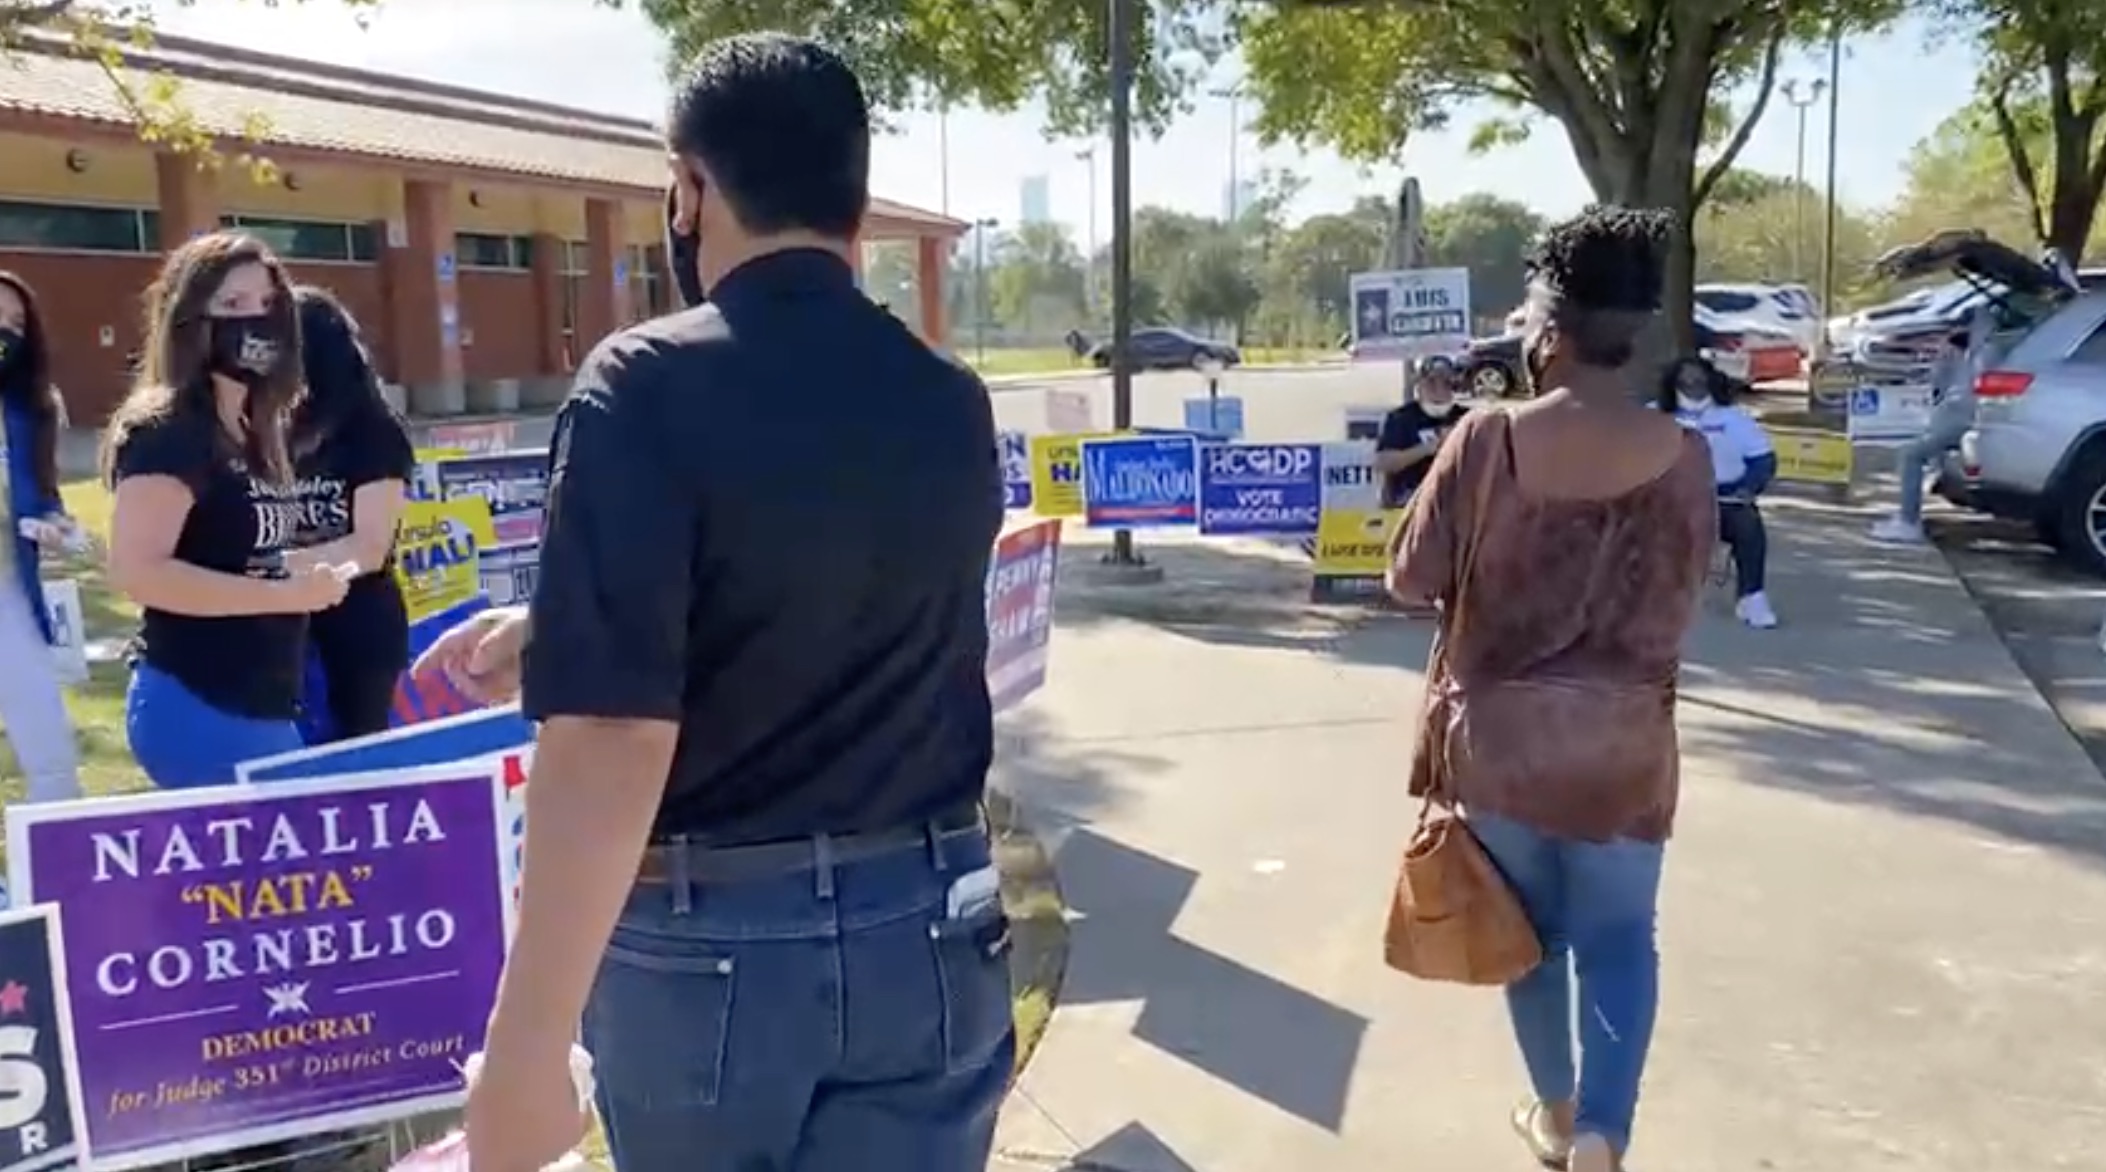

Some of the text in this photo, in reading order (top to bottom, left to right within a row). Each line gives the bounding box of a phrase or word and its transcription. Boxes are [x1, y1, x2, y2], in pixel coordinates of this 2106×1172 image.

[1235, 488, 1285, 507] VOTE
[91, 799, 446, 882] NATALIA
[181, 865, 373, 924] “NATA”
[96, 909, 454, 996] CORNELIO
[202, 1011, 376, 1061] DEMOCRAT
[108, 1088, 146, 1120] for
[154, 1074, 226, 1108] Judge
[303, 1047, 391, 1076] District
[400, 1034, 464, 1060] Court
